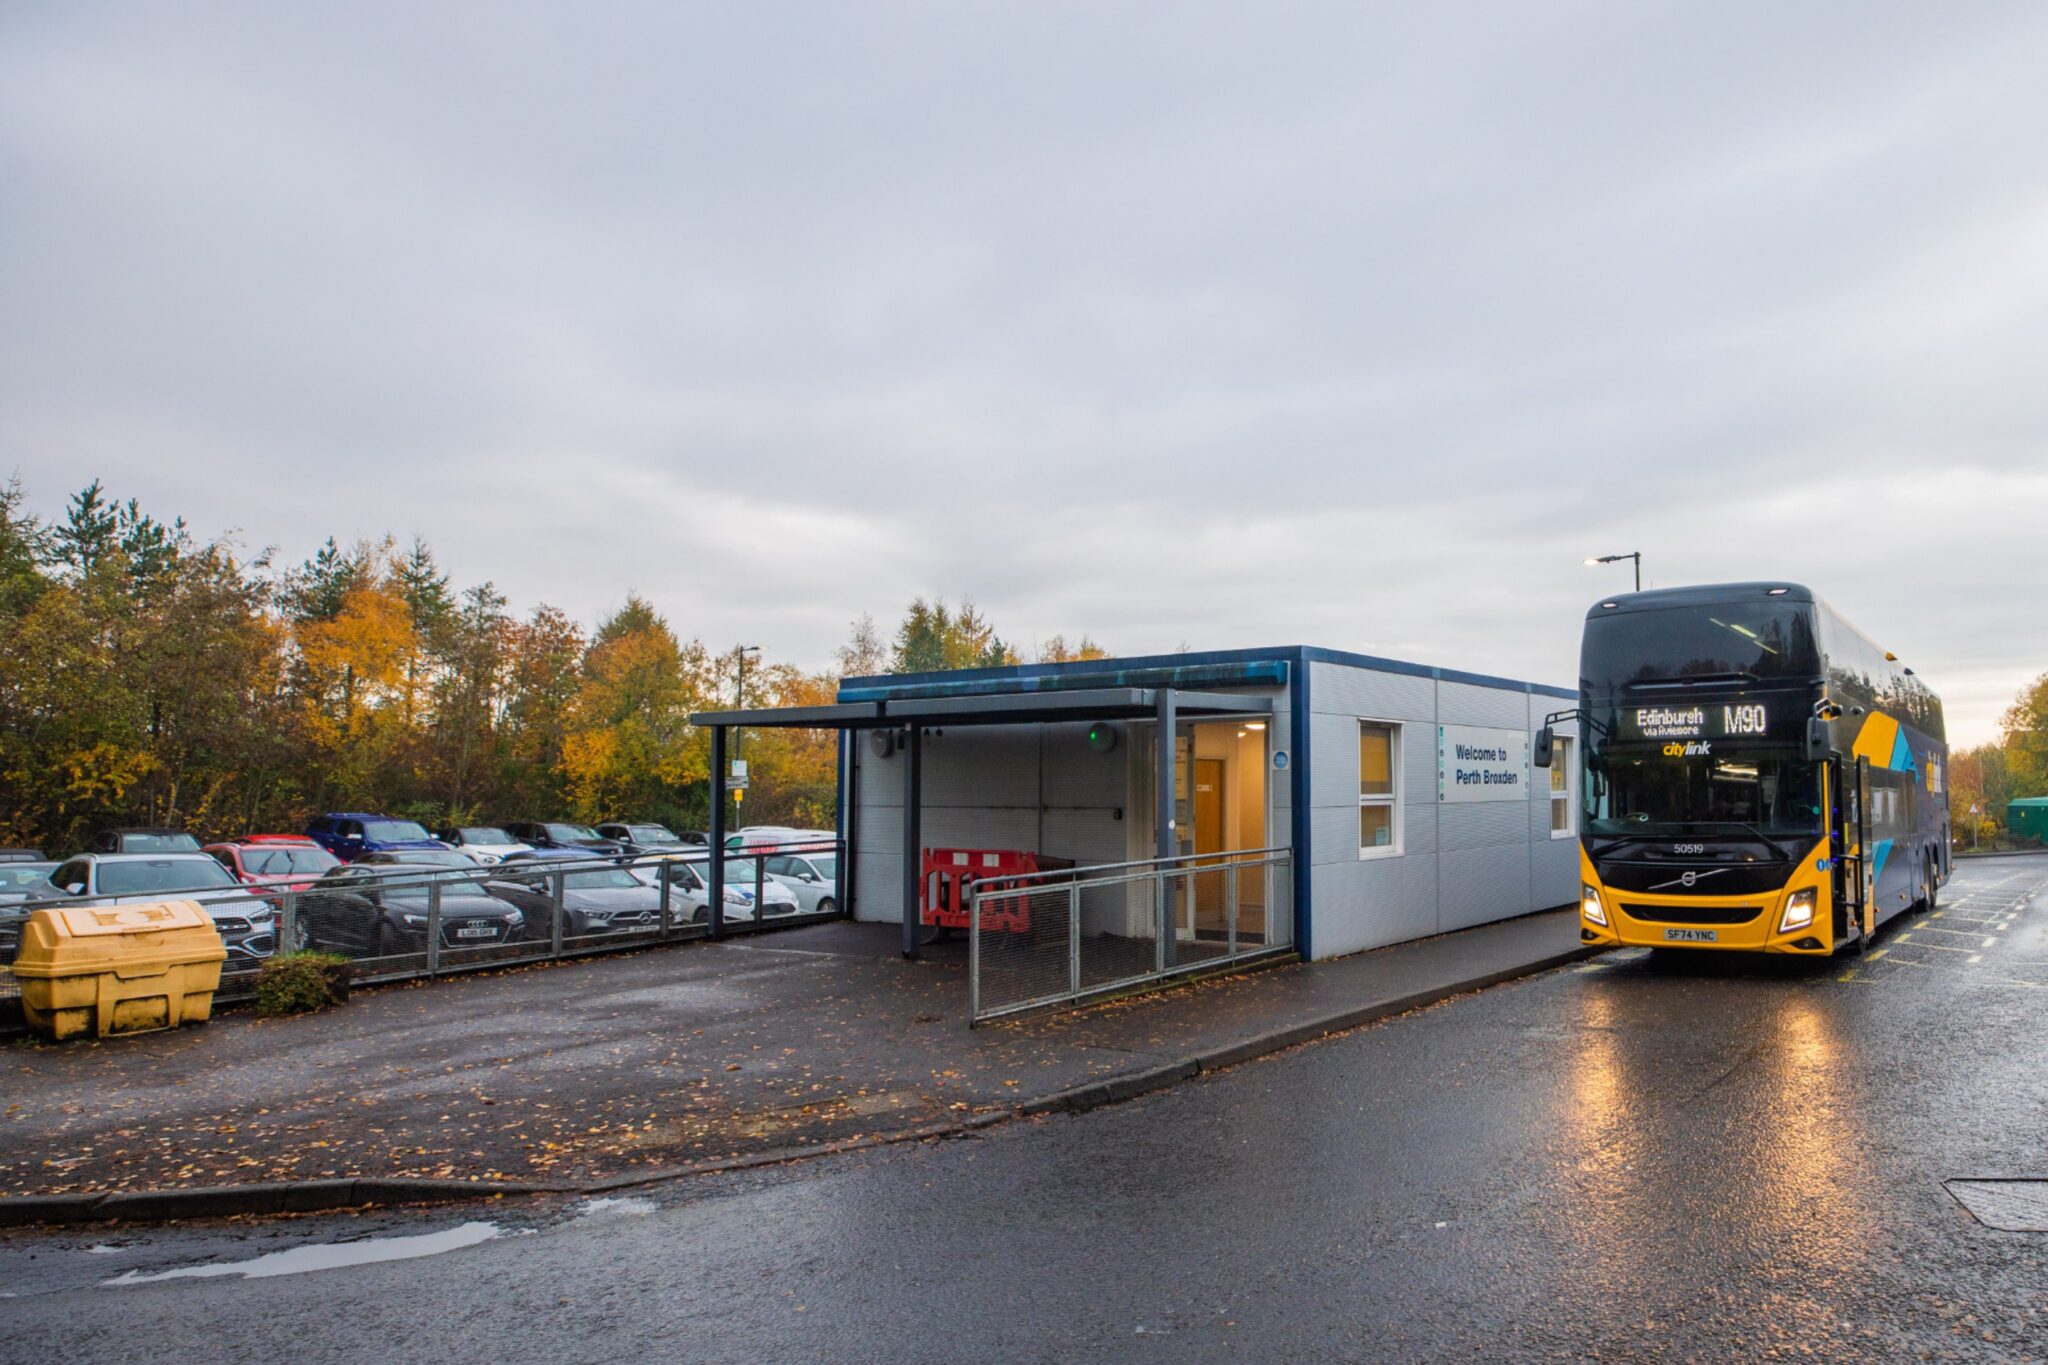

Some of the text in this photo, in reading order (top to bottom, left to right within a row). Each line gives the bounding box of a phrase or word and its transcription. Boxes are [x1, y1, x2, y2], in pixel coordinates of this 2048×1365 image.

[1636, 706, 1704, 726] Edinburgh
[1723, 704, 1767, 734] M90
[1643, 725, 1700, 737] via Aviemore
[1456, 744, 1507, 762] Welcome to
[1663, 740, 1712, 757] citylink
[1456, 768, 1518, 785] Perth Broxden
[1673, 843, 1704, 854] 50519
[1667, 929, 1714, 941] SF74 YNC
